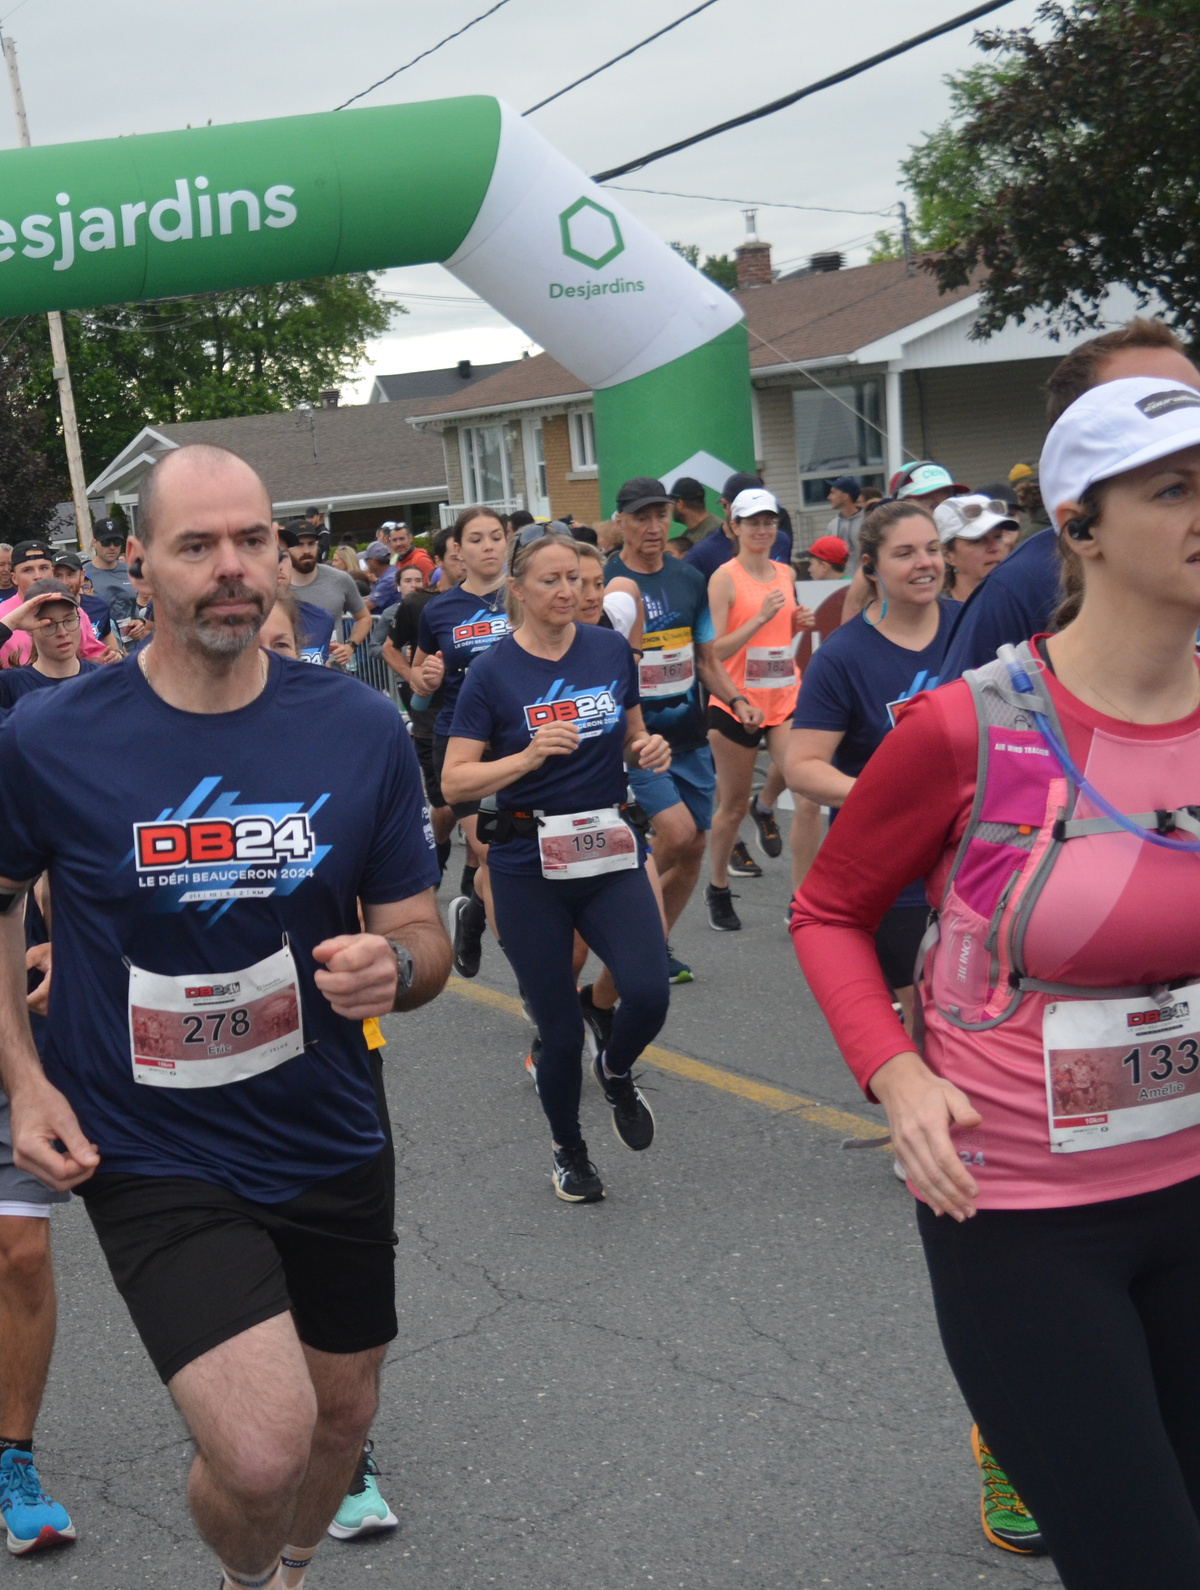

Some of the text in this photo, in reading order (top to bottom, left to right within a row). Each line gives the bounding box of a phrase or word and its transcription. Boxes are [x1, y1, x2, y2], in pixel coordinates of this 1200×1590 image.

[549, 277, 645, 300] Desjardins
[662, 663, 683, 677] 167
[766, 661, 786, 672] 182
[523, 690, 617, 731] DB24
[604, 717, 619, 725] 2024
[994, 742, 1006, 751] AIR
[1007, 744, 1023, 754] WIND
[133, 813, 316, 871] DB24
[571, 832, 607, 852] 195
[138, 867, 315, 888] LE DÉFI BEAUCERON 2024
[182, 1009, 251, 1044] 278
[208, 1043, 232, 1056] Éric
[1122, 1038, 1200, 1085] 133
[1137, 1082, 1185, 1101] Amélie
[1084, 1116, 1105, 1124] 10km
[959, 1150, 986, 1167] 24
